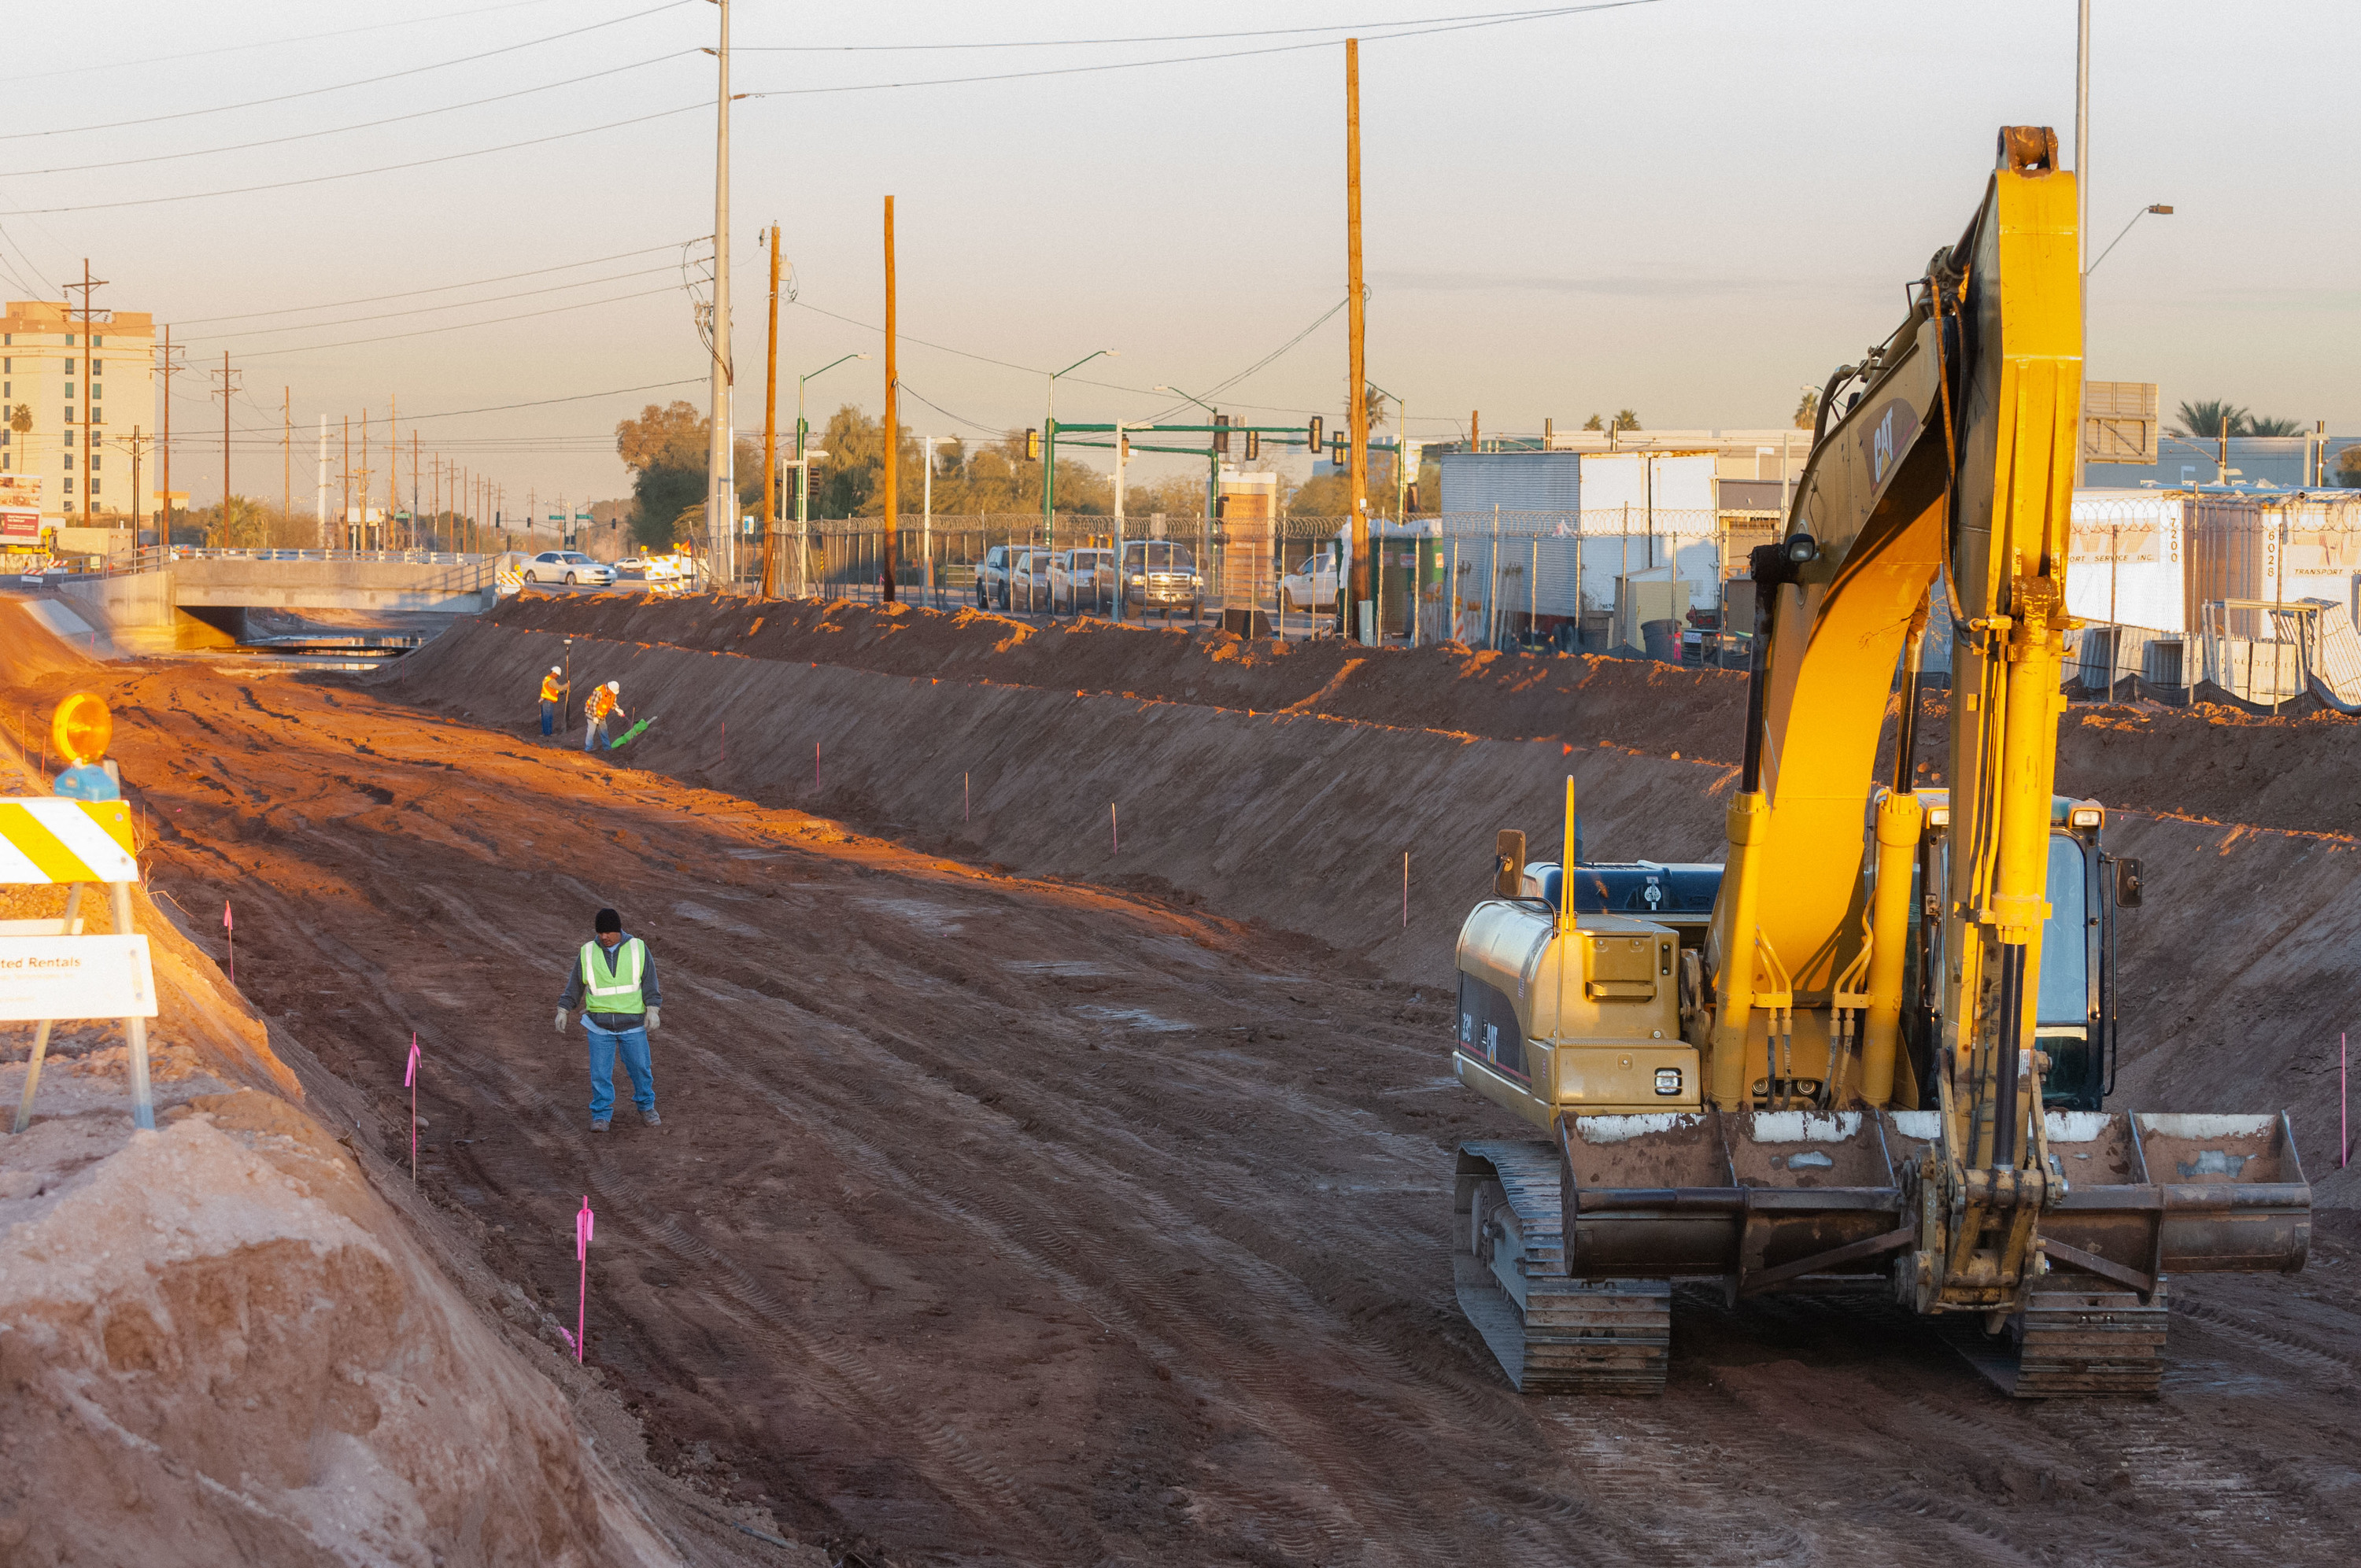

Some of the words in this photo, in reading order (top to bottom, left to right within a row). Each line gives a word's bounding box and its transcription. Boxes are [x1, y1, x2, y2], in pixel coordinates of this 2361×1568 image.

[1874, 406, 1894, 484] CAT
[2267, 530, 2276, 577] 6028
[28, 956, 82, 968] Rentals
